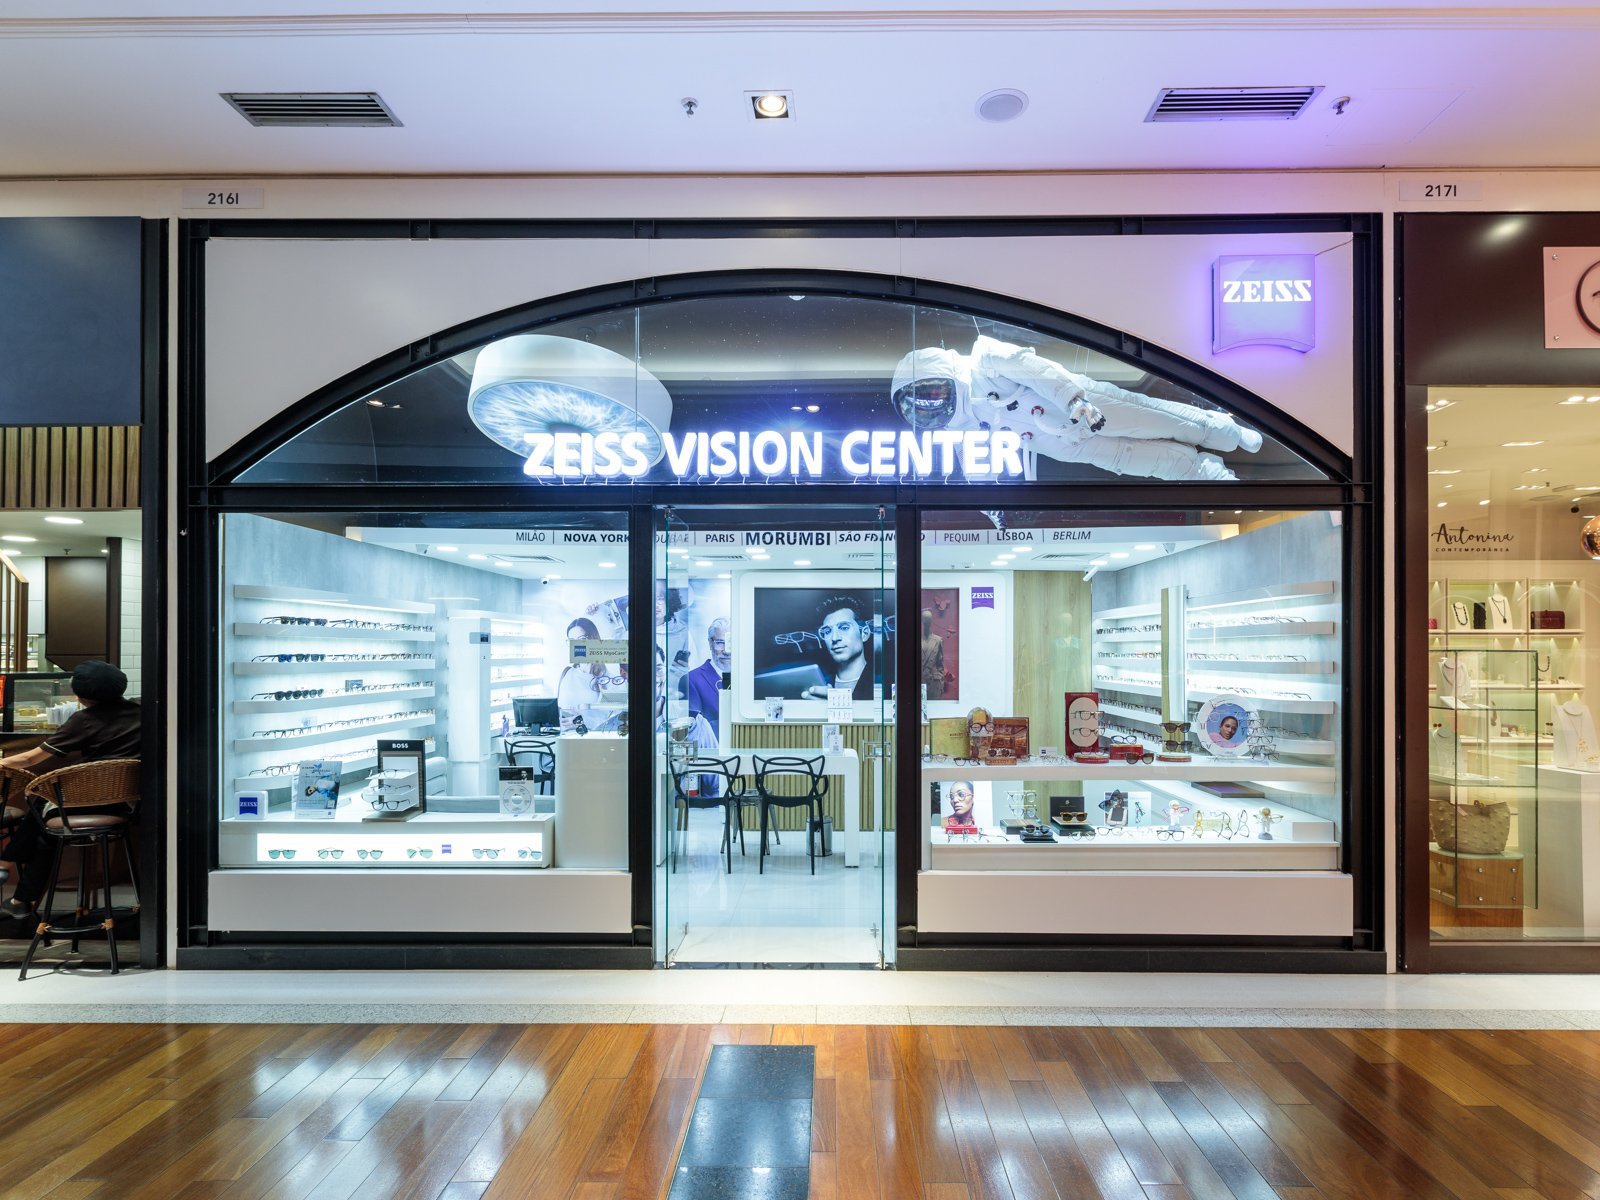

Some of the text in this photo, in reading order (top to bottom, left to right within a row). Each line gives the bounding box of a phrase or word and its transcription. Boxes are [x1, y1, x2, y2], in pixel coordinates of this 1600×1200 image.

[1222, 279, 1312, 303] ZEISS
[523, 430, 1024, 478] ZEISS VISION CENTER
[515, 530, 546, 542] MILÃO
[563, 533, 597, 543] NOVA
[705, 533, 735, 543] PARIS
[745, 531, 831, 546] MORUMBI
[838, 531, 861, 542] SÃO
[943, 533, 980, 543] PEQUIM
[1052, 531, 1091, 540] BERLIM
[1431, 523, 1513, 545] Antonina
